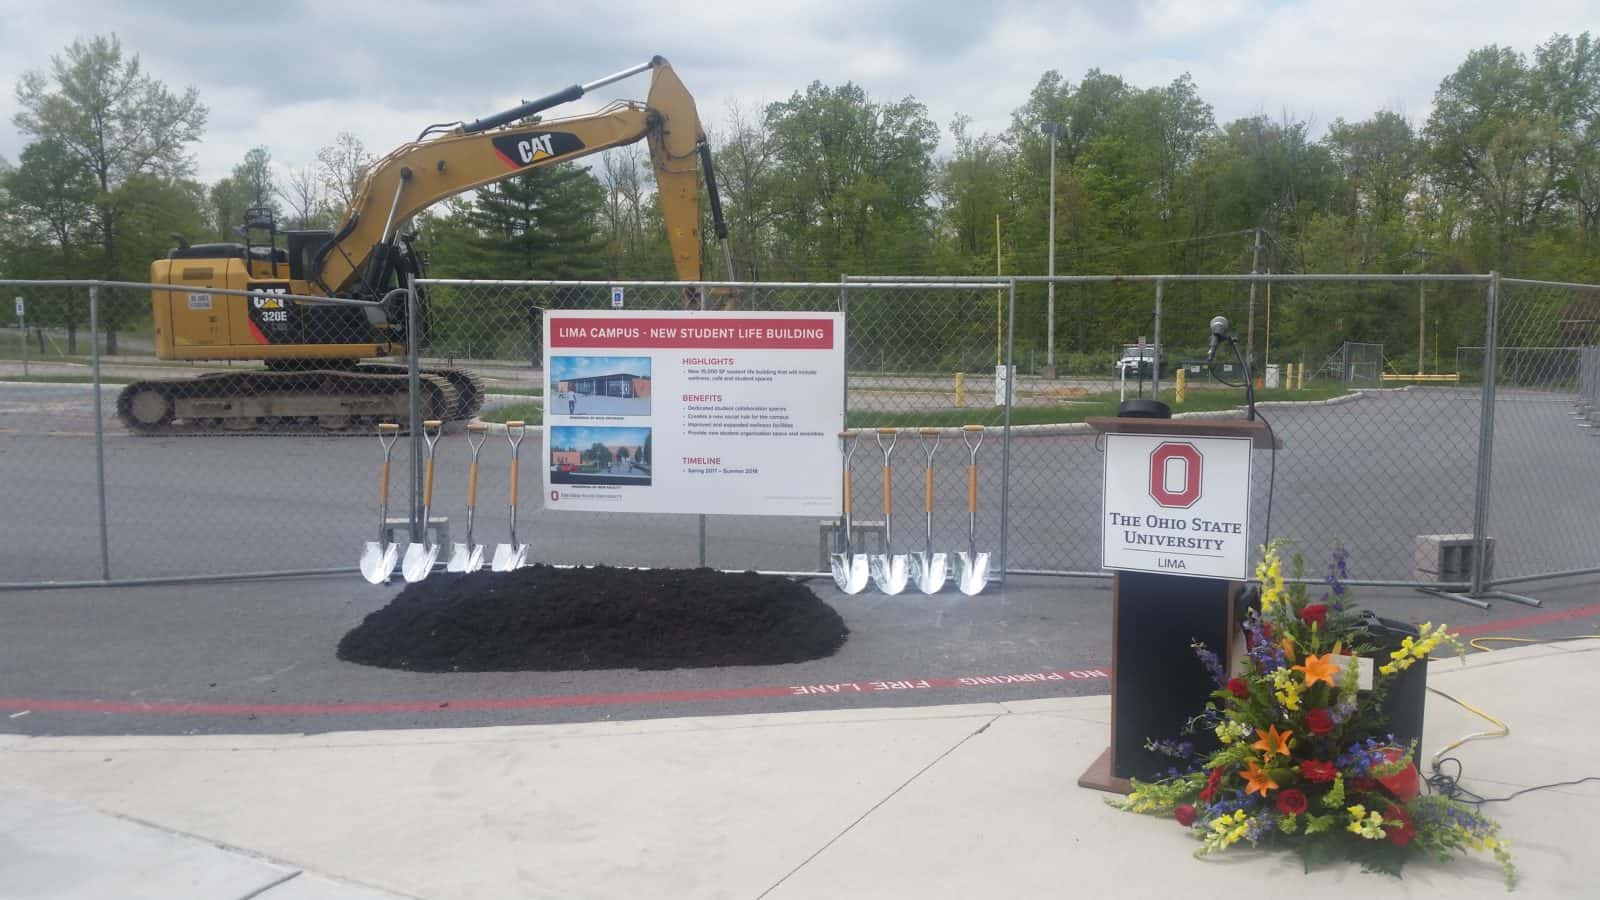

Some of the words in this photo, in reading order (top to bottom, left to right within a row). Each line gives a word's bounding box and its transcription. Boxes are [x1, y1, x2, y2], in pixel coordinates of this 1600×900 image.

[518, 133, 554, 163] CAT
[262, 311, 288, 322] 320E
[559, 327, 587, 338] LIMA
[590, 327, 640, 338] CAMPUS
[650, 328, 677, 338] NEW
[680, 328, 735, 339] STUDENT
[738, 328, 763, 339] LIFE
[766, 328, 824, 339] BUILDING
[682, 394, 722, 402] BENEFITS
[1149, 441, 1203, 509] O
[1109, 512, 1141, 527] THE
[1146, 515, 1187, 530] OHIO
[1192, 518, 1242, 534] STATE
[1124, 531, 1225, 550] UNIVERSITY
[1158, 558, 1187, 569] LIMA
[959, 672, 1064, 686] PARKING
[1069, 669, 1109, 679] NO
[789, 682, 861, 695] LANE
[869, 679, 932, 691] FIRE
